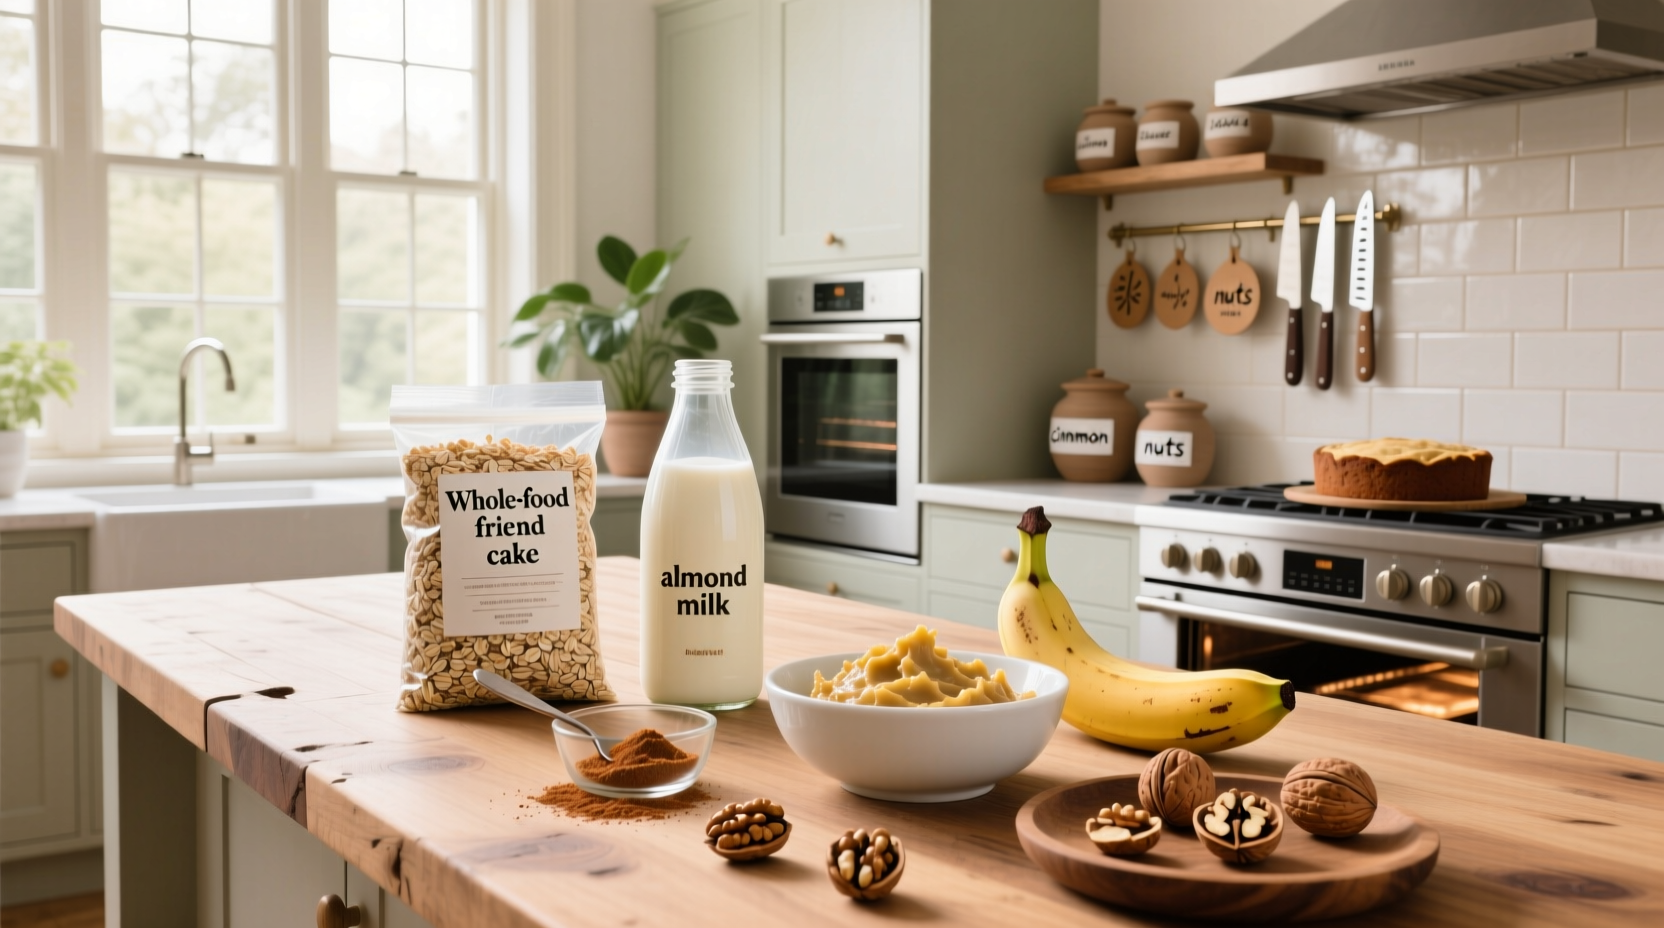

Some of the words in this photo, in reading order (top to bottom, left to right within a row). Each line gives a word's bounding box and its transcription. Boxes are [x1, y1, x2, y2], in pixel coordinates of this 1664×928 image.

[1214, 282, 1253, 305] nuts
[1144, 437, 1184, 457] nuts
[445, 486, 570, 512] Whole-food
[475, 514, 545, 537] friend
[487, 542, 540, 565] cake
[661, 564, 747, 588] almond
[677, 592, 730, 615] milk
